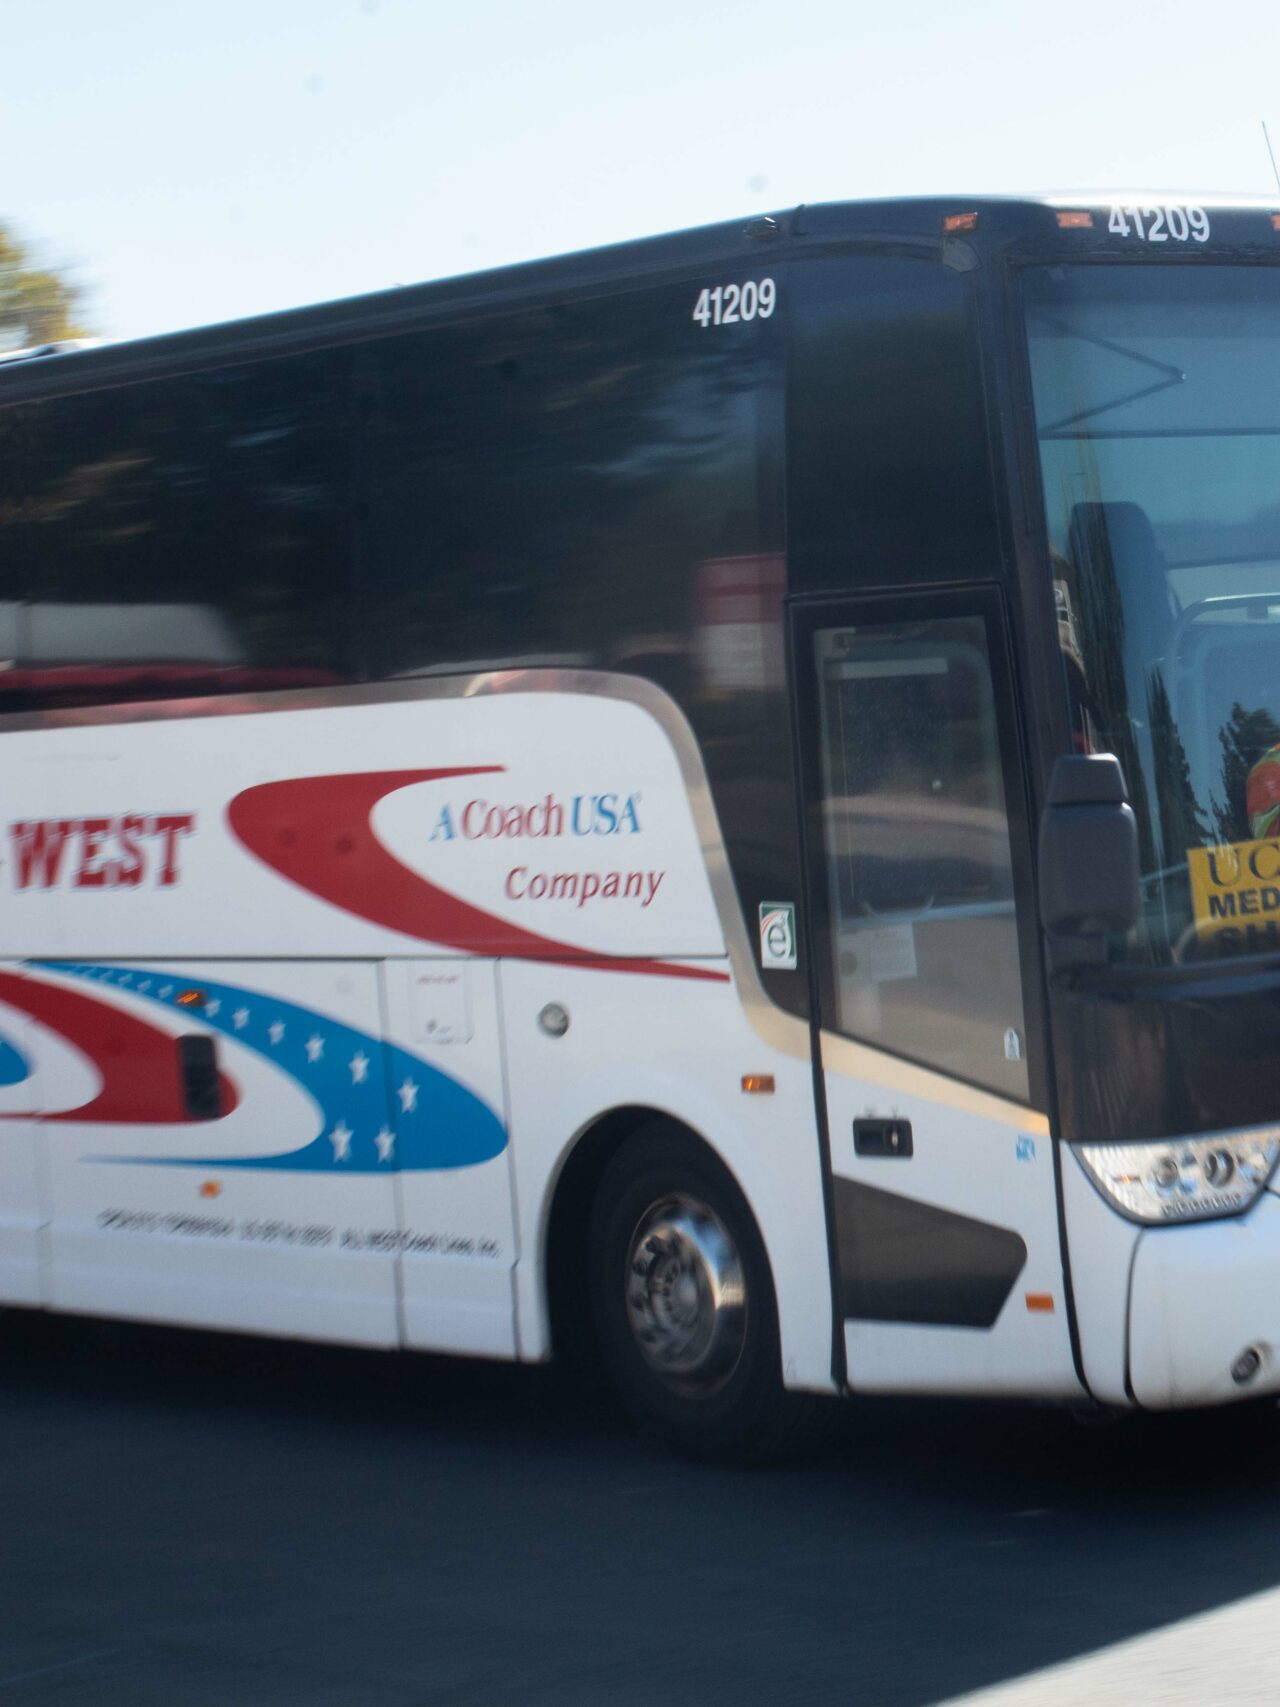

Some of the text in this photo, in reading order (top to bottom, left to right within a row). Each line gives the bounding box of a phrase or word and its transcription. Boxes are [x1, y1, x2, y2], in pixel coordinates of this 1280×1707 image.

[1108, 205, 1210, 242] 41209
[692, 278, 776, 327] 41209
[429, 793, 641, 841] A Coach USA
[10, 814, 195, 889] WEST
[505, 866, 666, 908] Company
